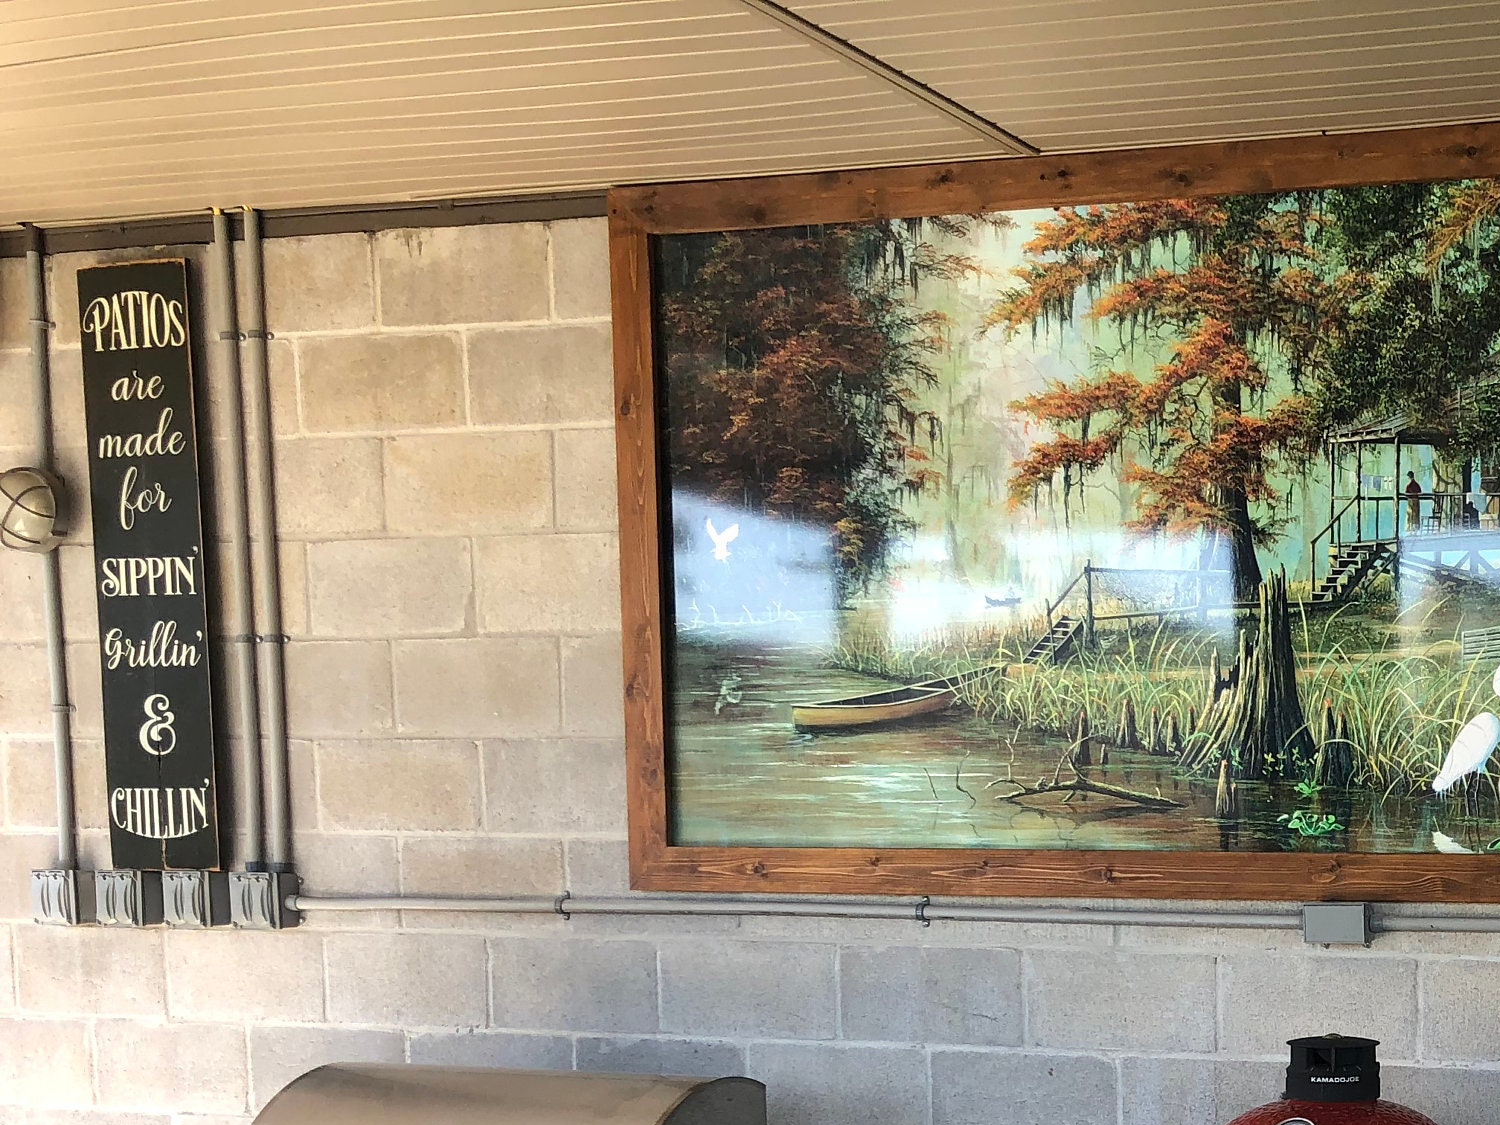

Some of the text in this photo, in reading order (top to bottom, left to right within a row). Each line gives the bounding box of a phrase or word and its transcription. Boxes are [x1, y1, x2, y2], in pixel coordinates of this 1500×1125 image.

[82, 290, 186, 352] PATIOS
[111, 369, 165, 401] are
[98, 407, 186, 459] made
[119, 466, 172, 531] for
[101, 546, 198, 597] SIPPIN'
[104, 620, 203, 670] Grillin'
[139, 693, 177, 756] &
[110, 778, 210, 839] CHILLIN'
